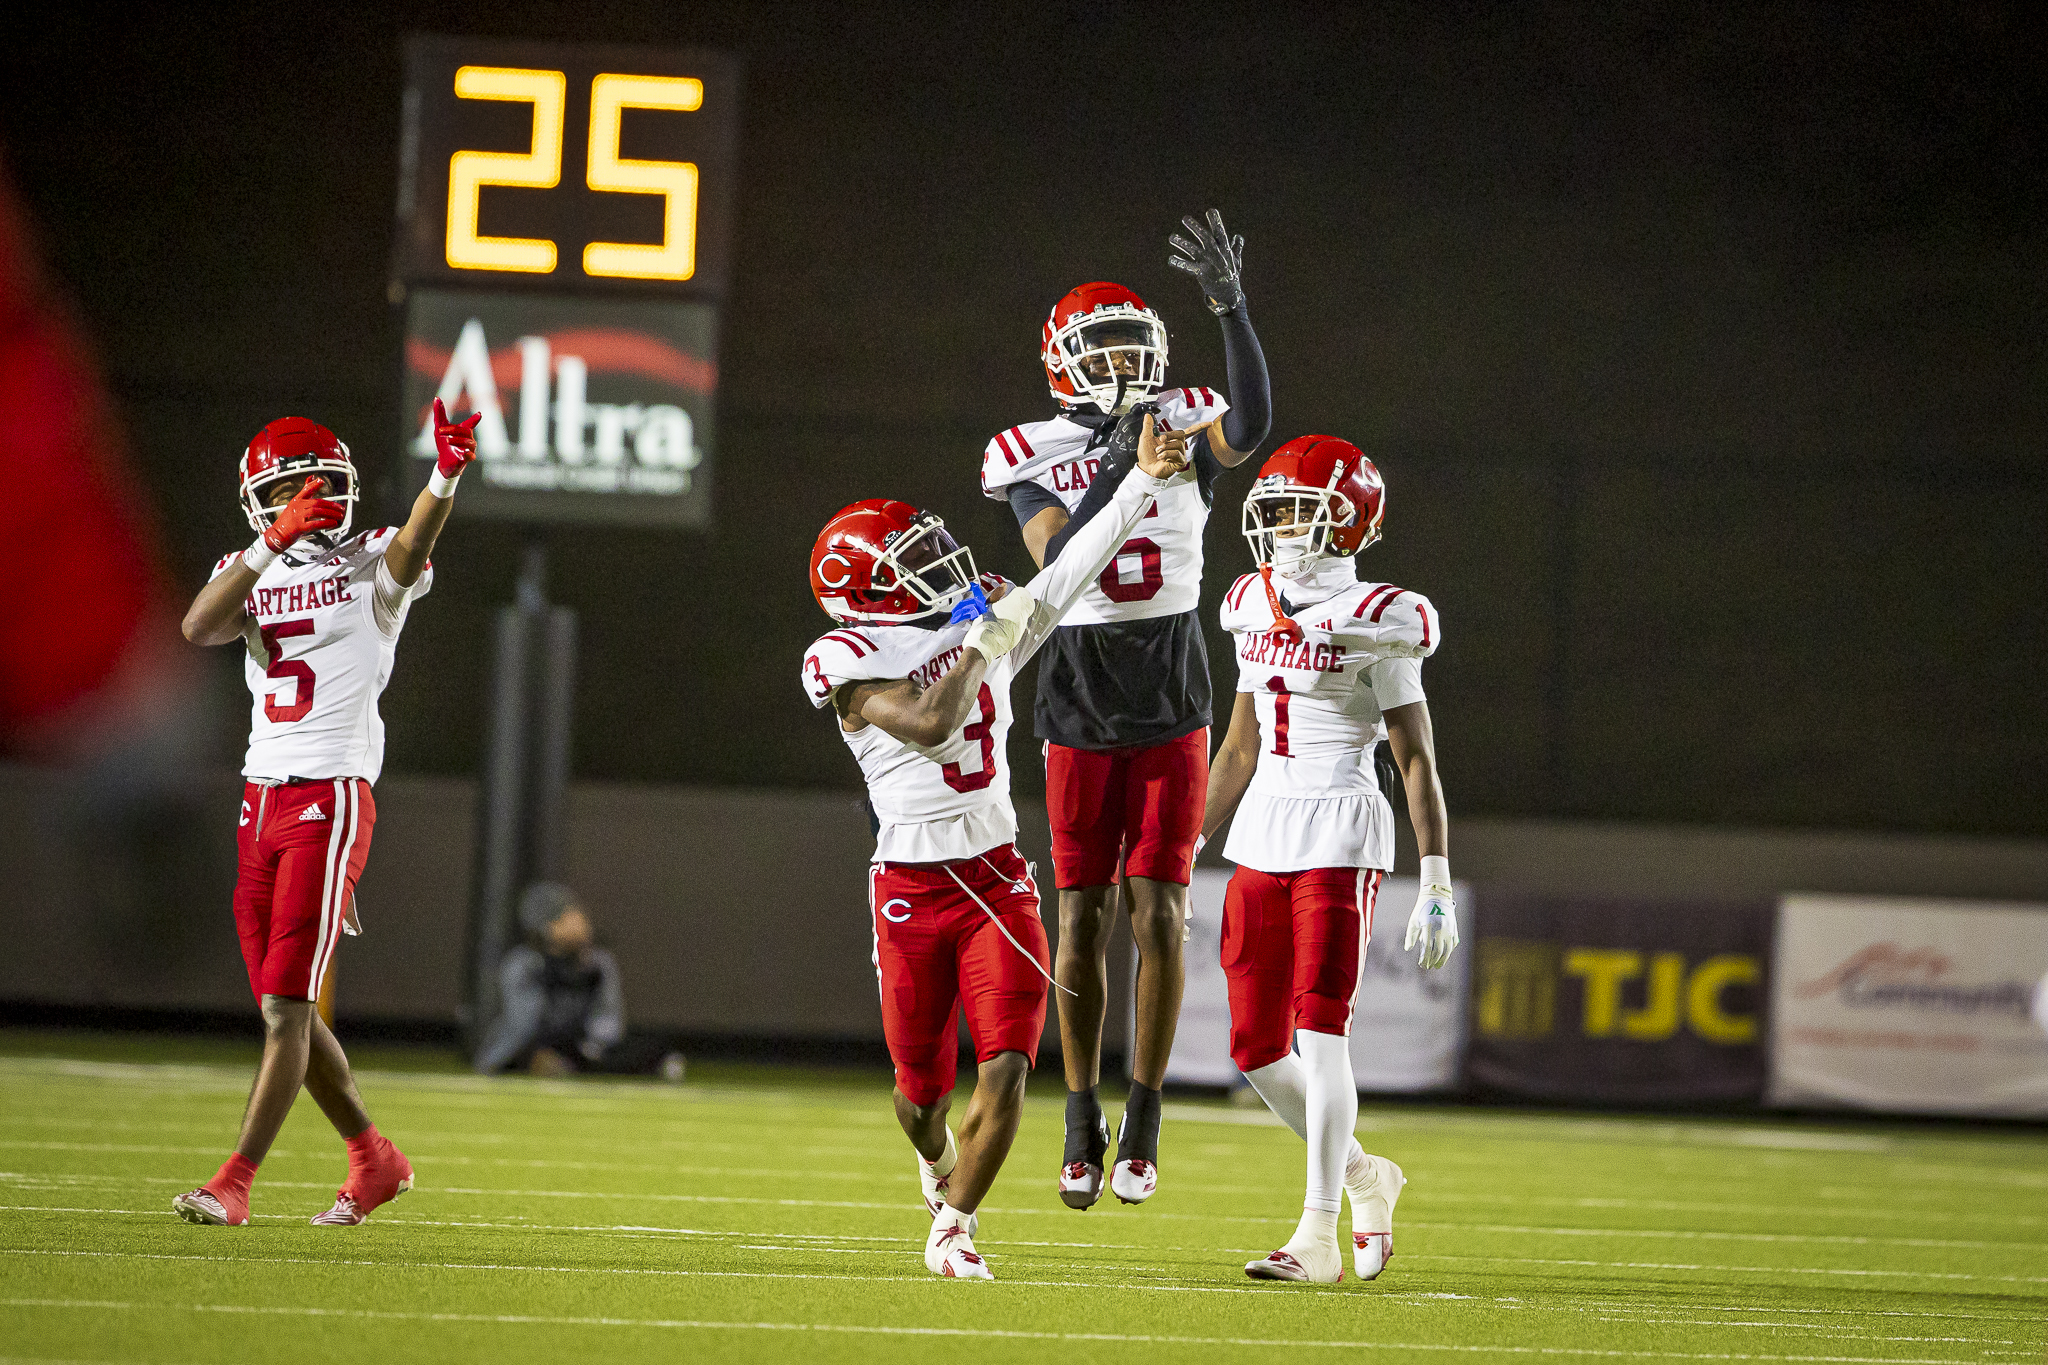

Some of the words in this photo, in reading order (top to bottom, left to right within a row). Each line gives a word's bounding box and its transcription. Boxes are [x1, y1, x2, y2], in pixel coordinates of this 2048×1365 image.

[446, 65, 704, 281] 25
[407, 316, 702, 471] Altra
[245, 575, 352, 617] ARTHAGE
[817, 553, 852, 589] C
[1415, 603, 1431, 649] 1
[260, 618, 316, 723] 5
[805, 654, 832, 698] 3
[942, 681, 997, 793] 3
[1265, 675, 1296, 758] 1
[880, 898, 913, 923] C
[1564, 947, 1761, 1039] TJC
